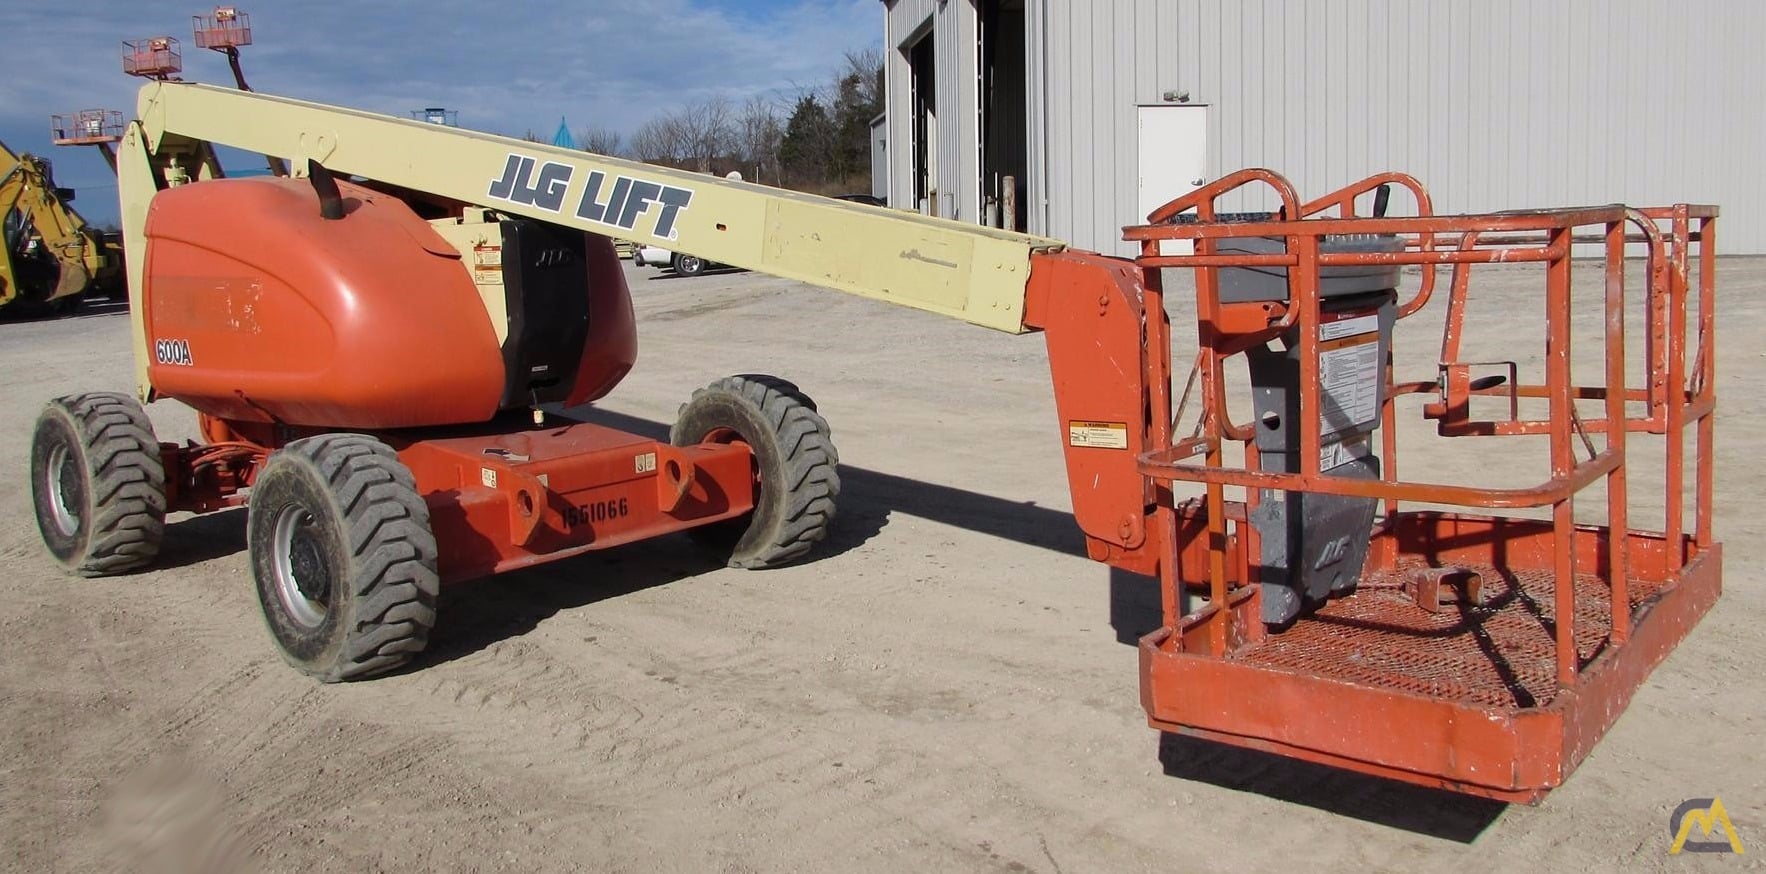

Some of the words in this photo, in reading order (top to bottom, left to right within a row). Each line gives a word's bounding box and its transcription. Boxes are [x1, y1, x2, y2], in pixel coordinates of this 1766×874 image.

[488, 154, 574, 212] JLG
[576, 171, 694, 239] LIFT
[156, 339, 193, 366] 600A
